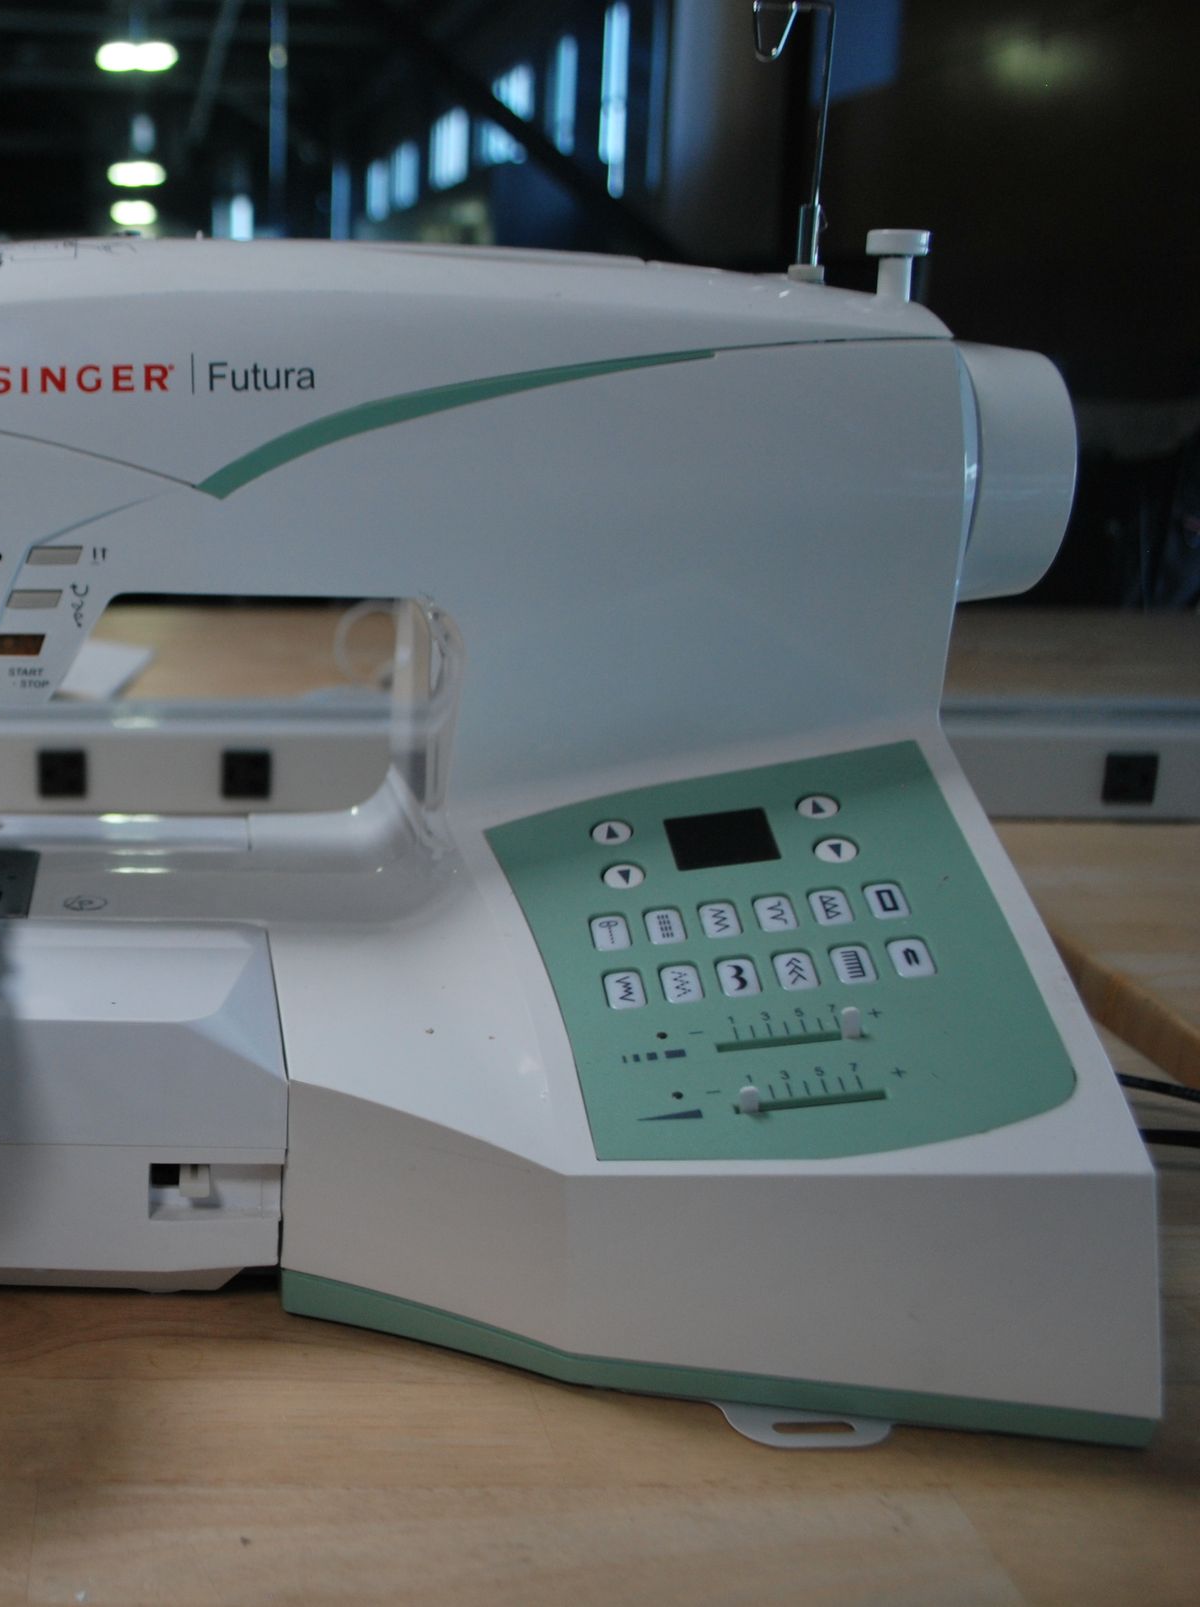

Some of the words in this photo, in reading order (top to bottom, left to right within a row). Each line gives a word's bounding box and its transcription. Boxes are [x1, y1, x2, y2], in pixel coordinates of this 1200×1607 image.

[208, 361, 316, 392] Futura
[9, 667, 44, 677] START
[20, 680, 50, 689] STOP
[760, 1011, 771, 1021] 3
[795, 1008, 805, 1017] 5
[780, 1070, 791, 1080] 3
[849, 1063, 858, 1072] 7
